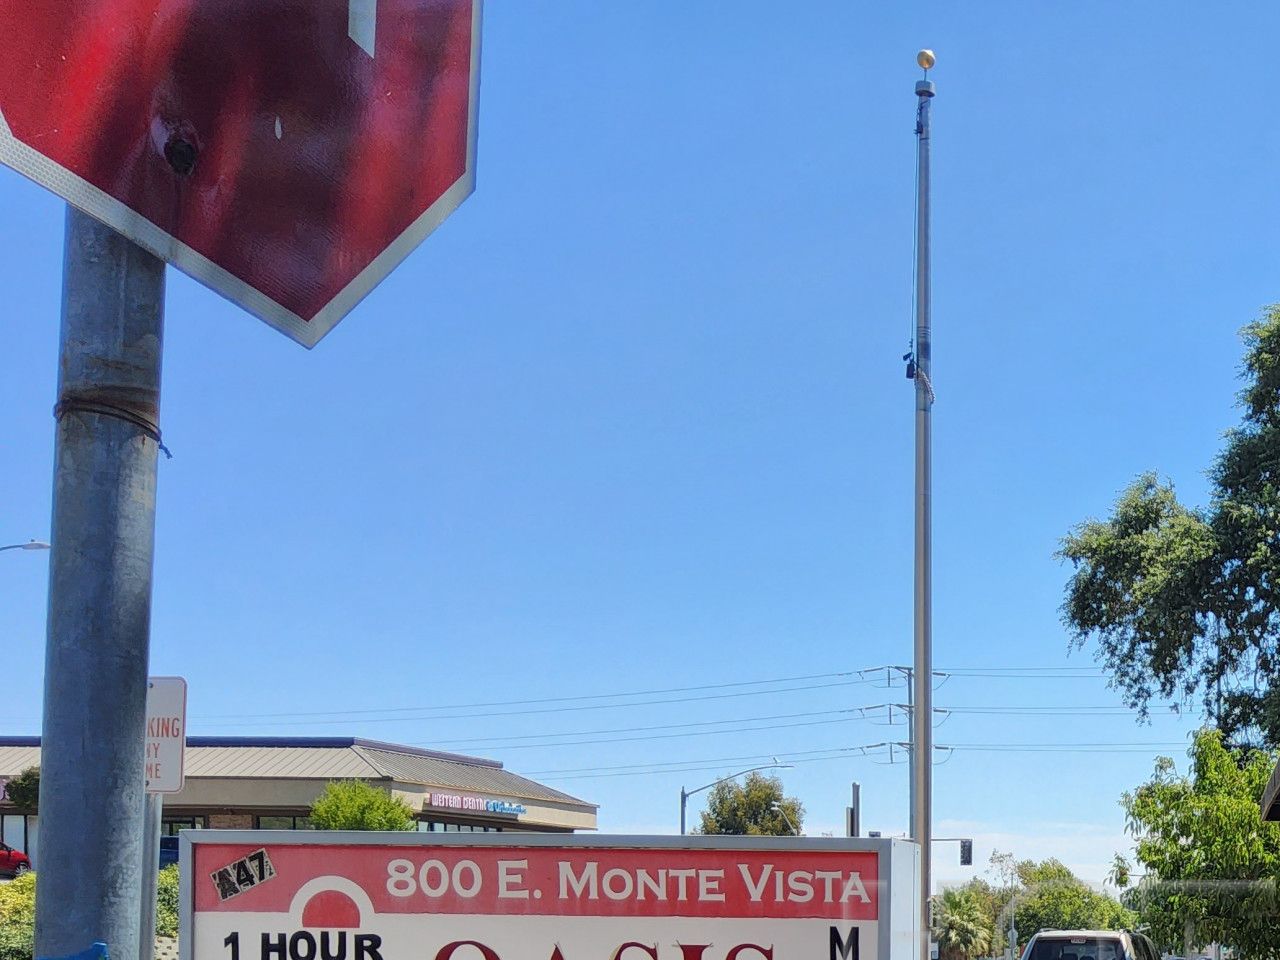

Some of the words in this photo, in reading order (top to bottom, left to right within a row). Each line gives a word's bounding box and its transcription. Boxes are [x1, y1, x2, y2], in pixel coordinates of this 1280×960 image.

[386, 858, 482, 898] 800
[497, 859, 542, 899] E.
[558, 861, 725, 901] MONTE
[738, 864, 871, 903] VISTA
